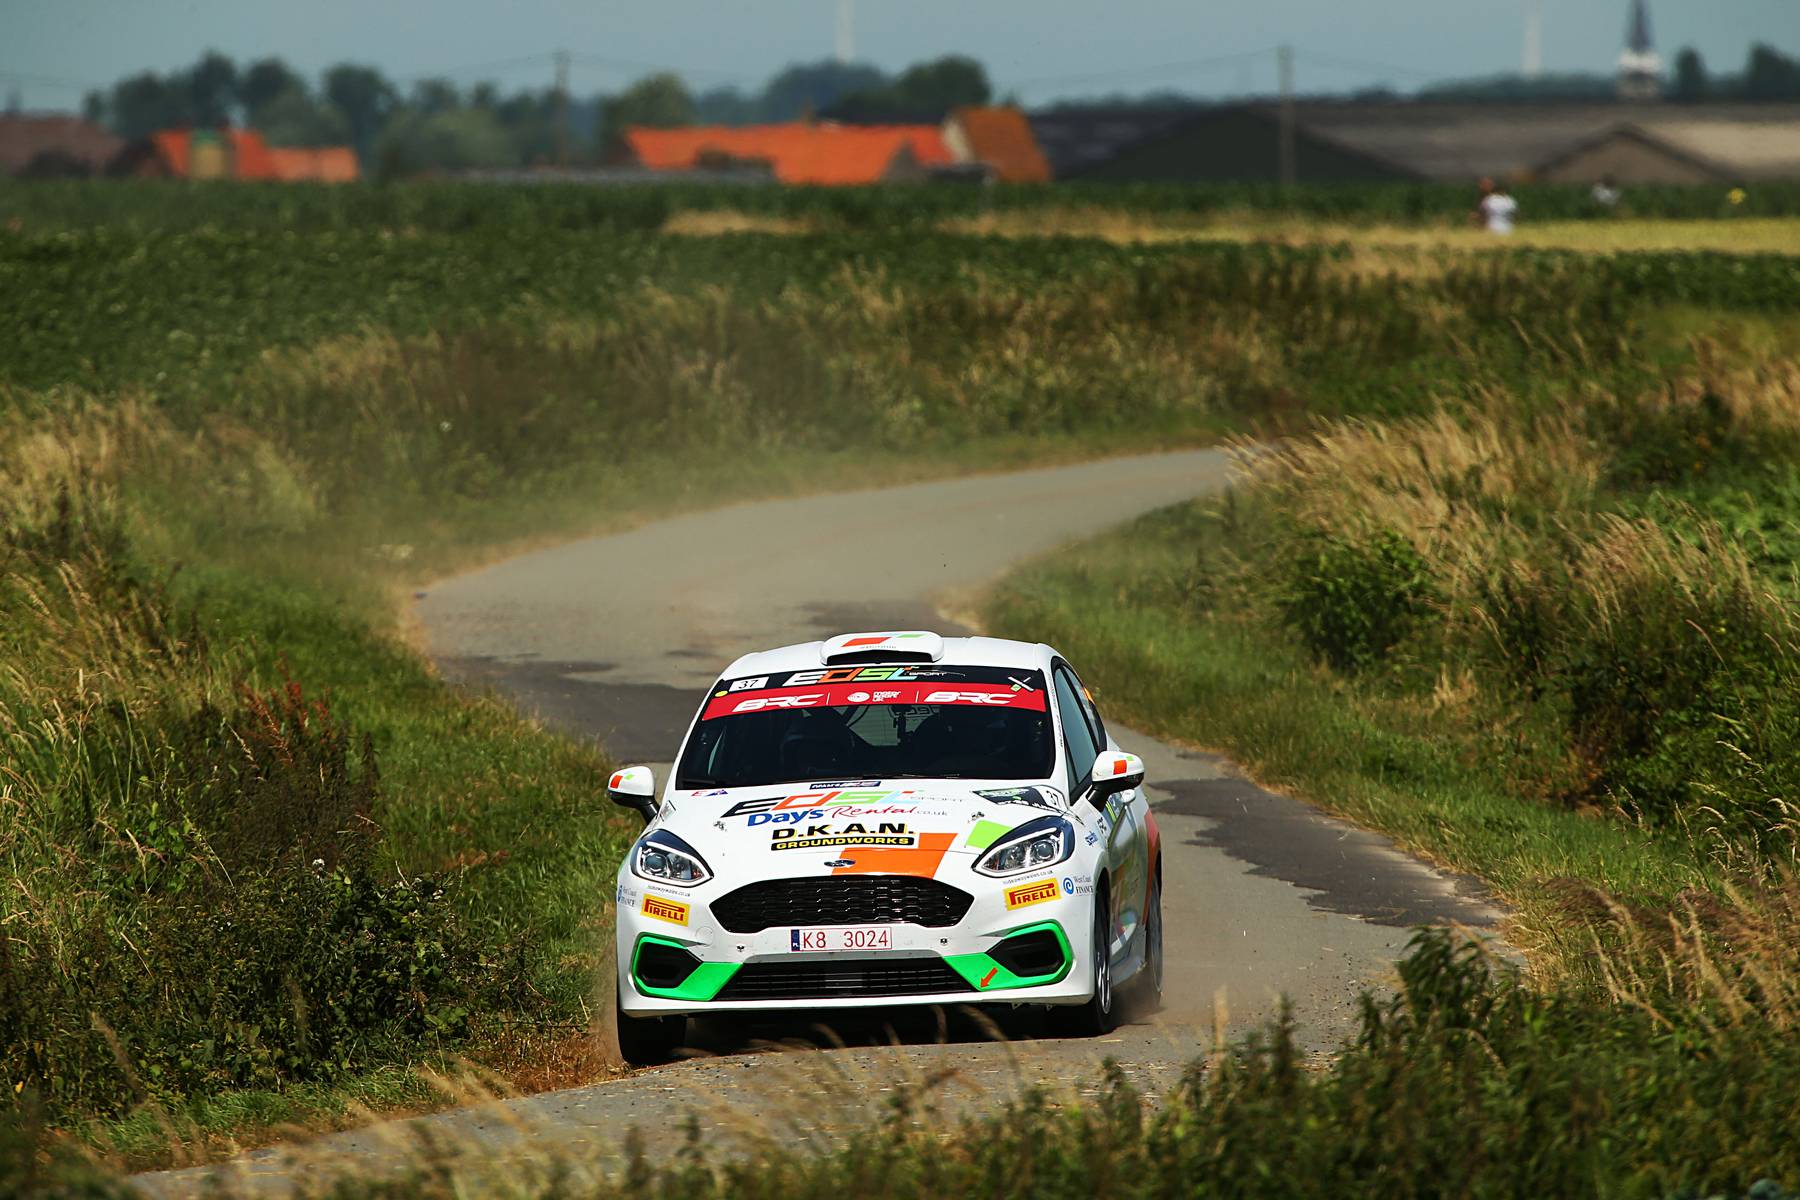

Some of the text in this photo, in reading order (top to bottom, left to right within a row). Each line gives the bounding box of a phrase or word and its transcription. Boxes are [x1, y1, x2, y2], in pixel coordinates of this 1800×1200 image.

[738, 679, 759, 690] 37
[732, 693, 825, 713] BRC
[924, 691, 1018, 705] BRC
[747, 808, 824, 827] Days
[772, 823, 916, 840] D.K.A.N.
[775, 836, 910, 850] GROUNDWORKS
[1009, 882, 1056, 906] PIRELLI
[643, 898, 685, 922] PIRELLI
[803, 930, 888, 949] K8 3024
